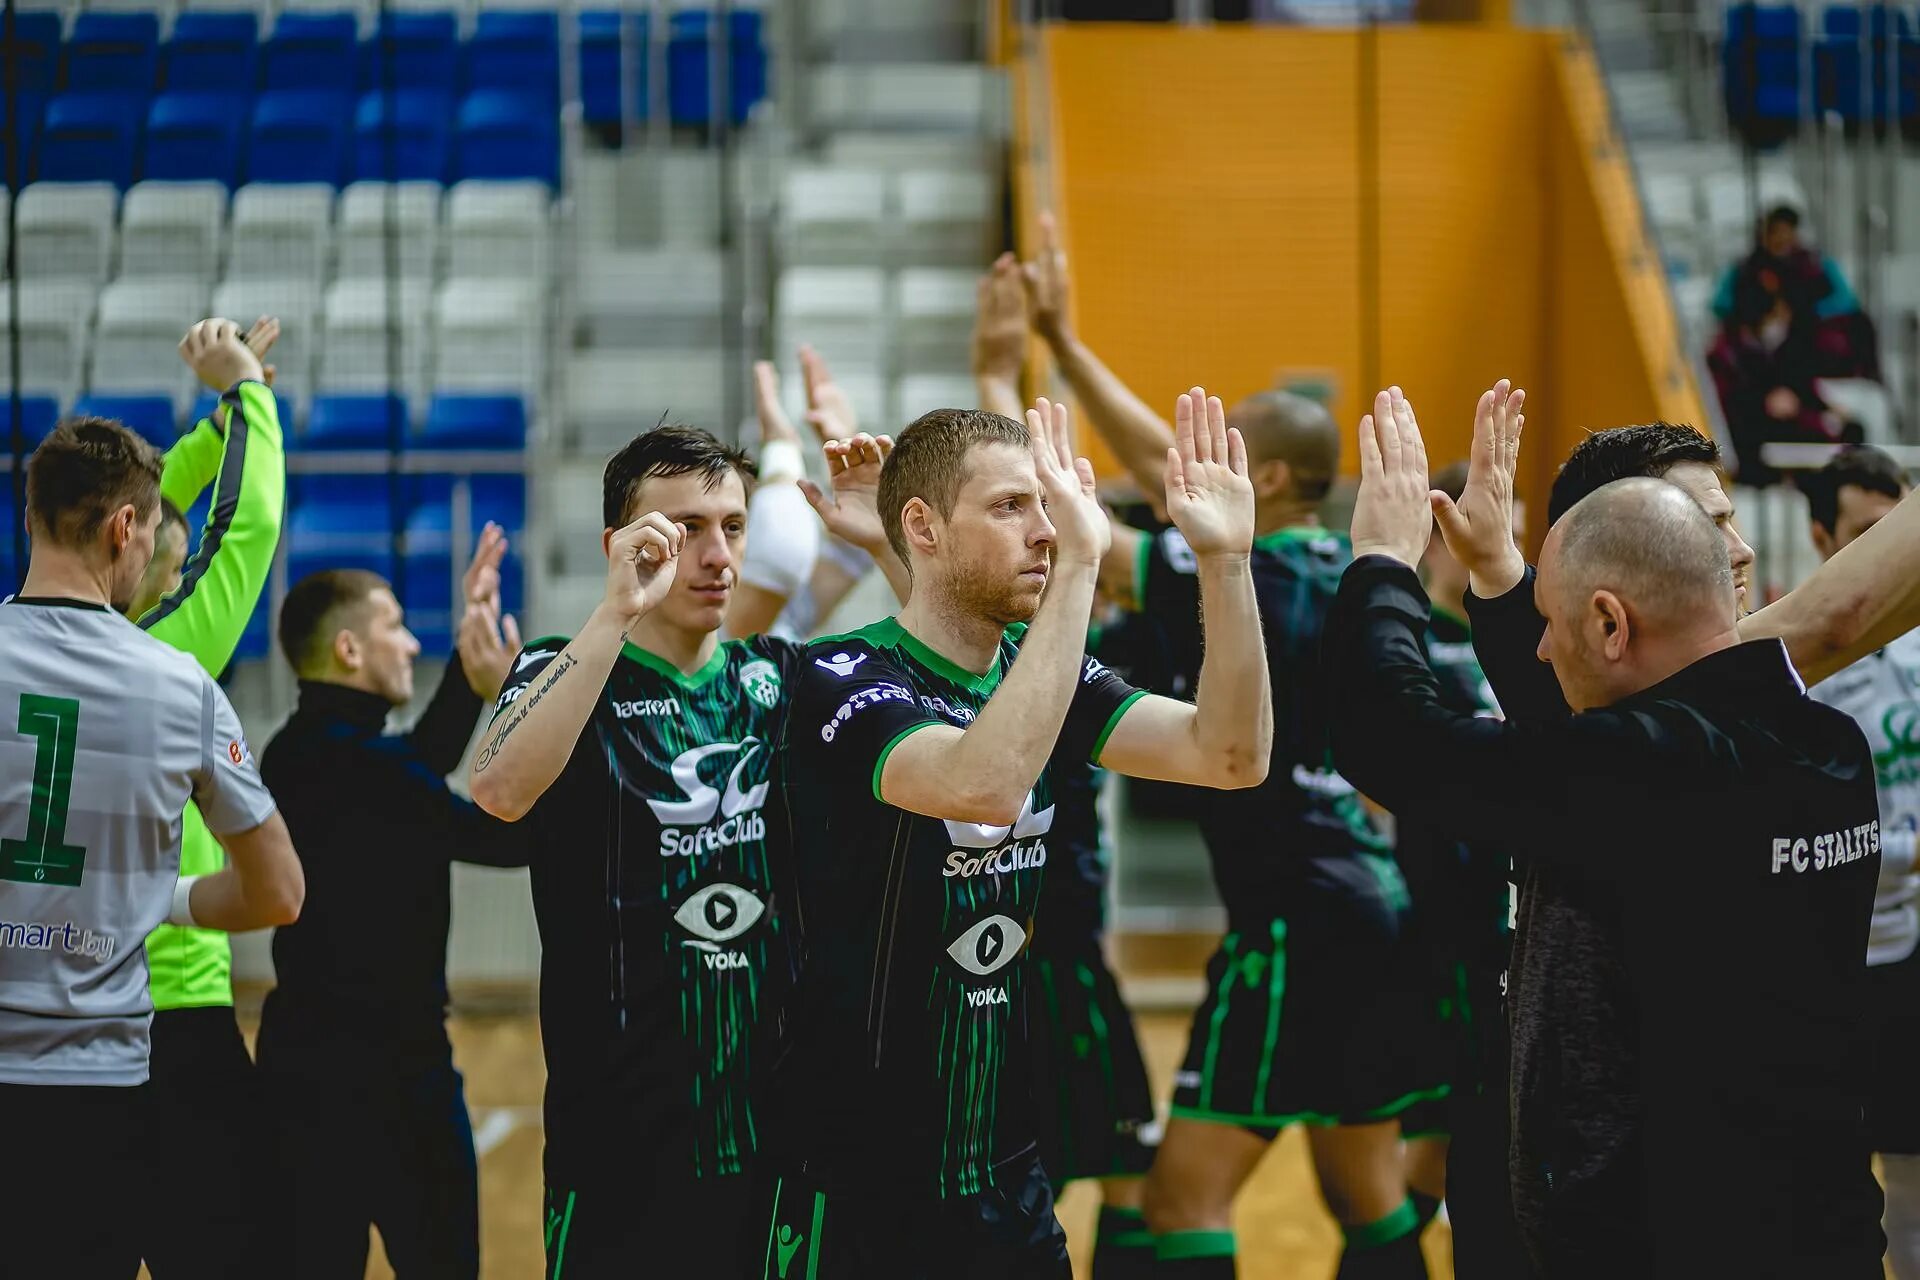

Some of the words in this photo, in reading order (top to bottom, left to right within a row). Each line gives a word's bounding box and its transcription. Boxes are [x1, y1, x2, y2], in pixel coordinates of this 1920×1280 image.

[0, 693, 86, 886] 1
[660, 811, 766, 857] SoftClub
[1771, 837, 1810, 873] FC
[1813, 819, 1882, 871] STALITS
[942, 838, 1047, 878] SoftClub
[704, 951, 750, 971] VOKA
[966, 986, 1009, 1008] VOKA
